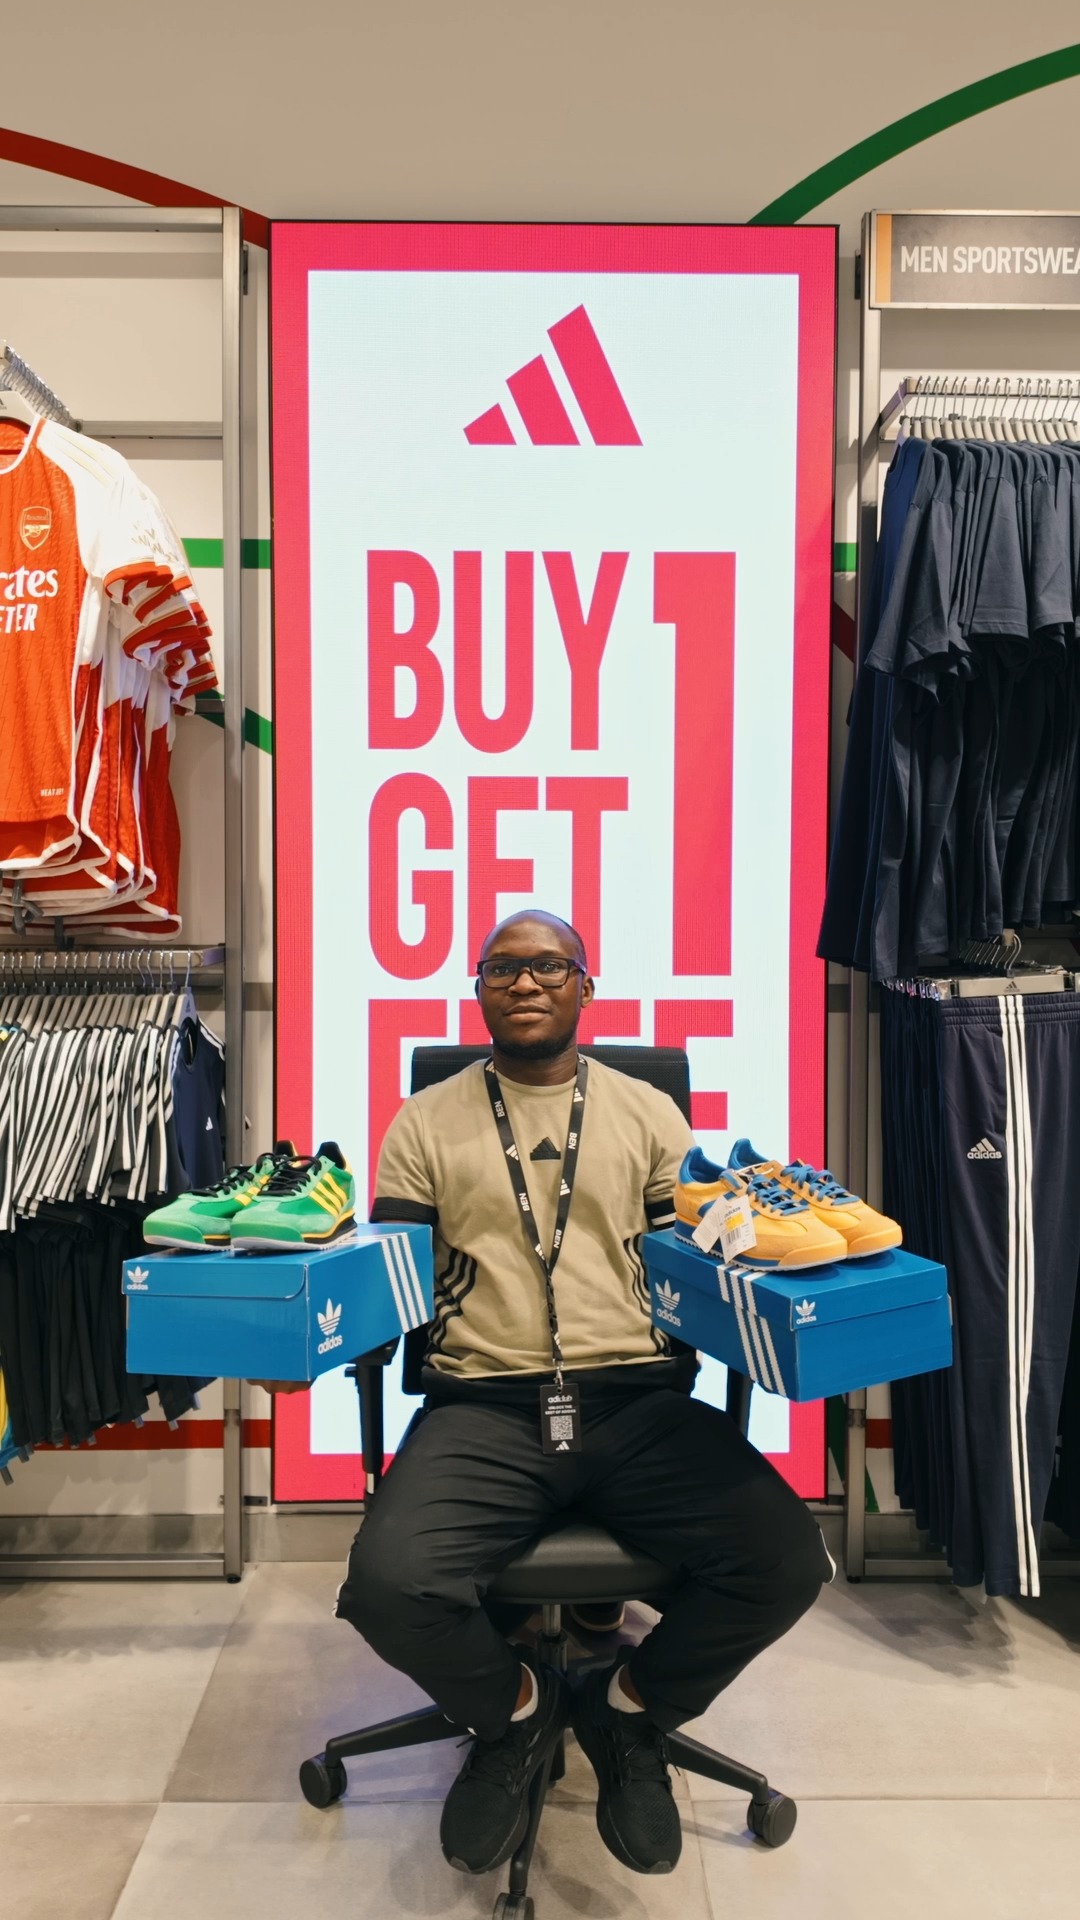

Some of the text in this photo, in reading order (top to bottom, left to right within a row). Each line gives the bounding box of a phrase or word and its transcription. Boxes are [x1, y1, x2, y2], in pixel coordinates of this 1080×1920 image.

[901, 245, 948, 273] MEN
[367, 549, 737, 976] BUY 1
[368, 772, 629, 980] GET
[494, 1101, 505, 1118] BEN
[568, 1132, 577, 1150] BEN
[967, 1151, 1002, 1160] adidas
[519, 1192, 530, 1211] BEN
[554, 1229, 562, 1249] BEN
[127, 1283, 149, 1291] adidas
[656, 1308, 682, 1328] adidas
[796, 1315, 817, 1325] adidas
[318, 1335, 343, 1355] adidas
